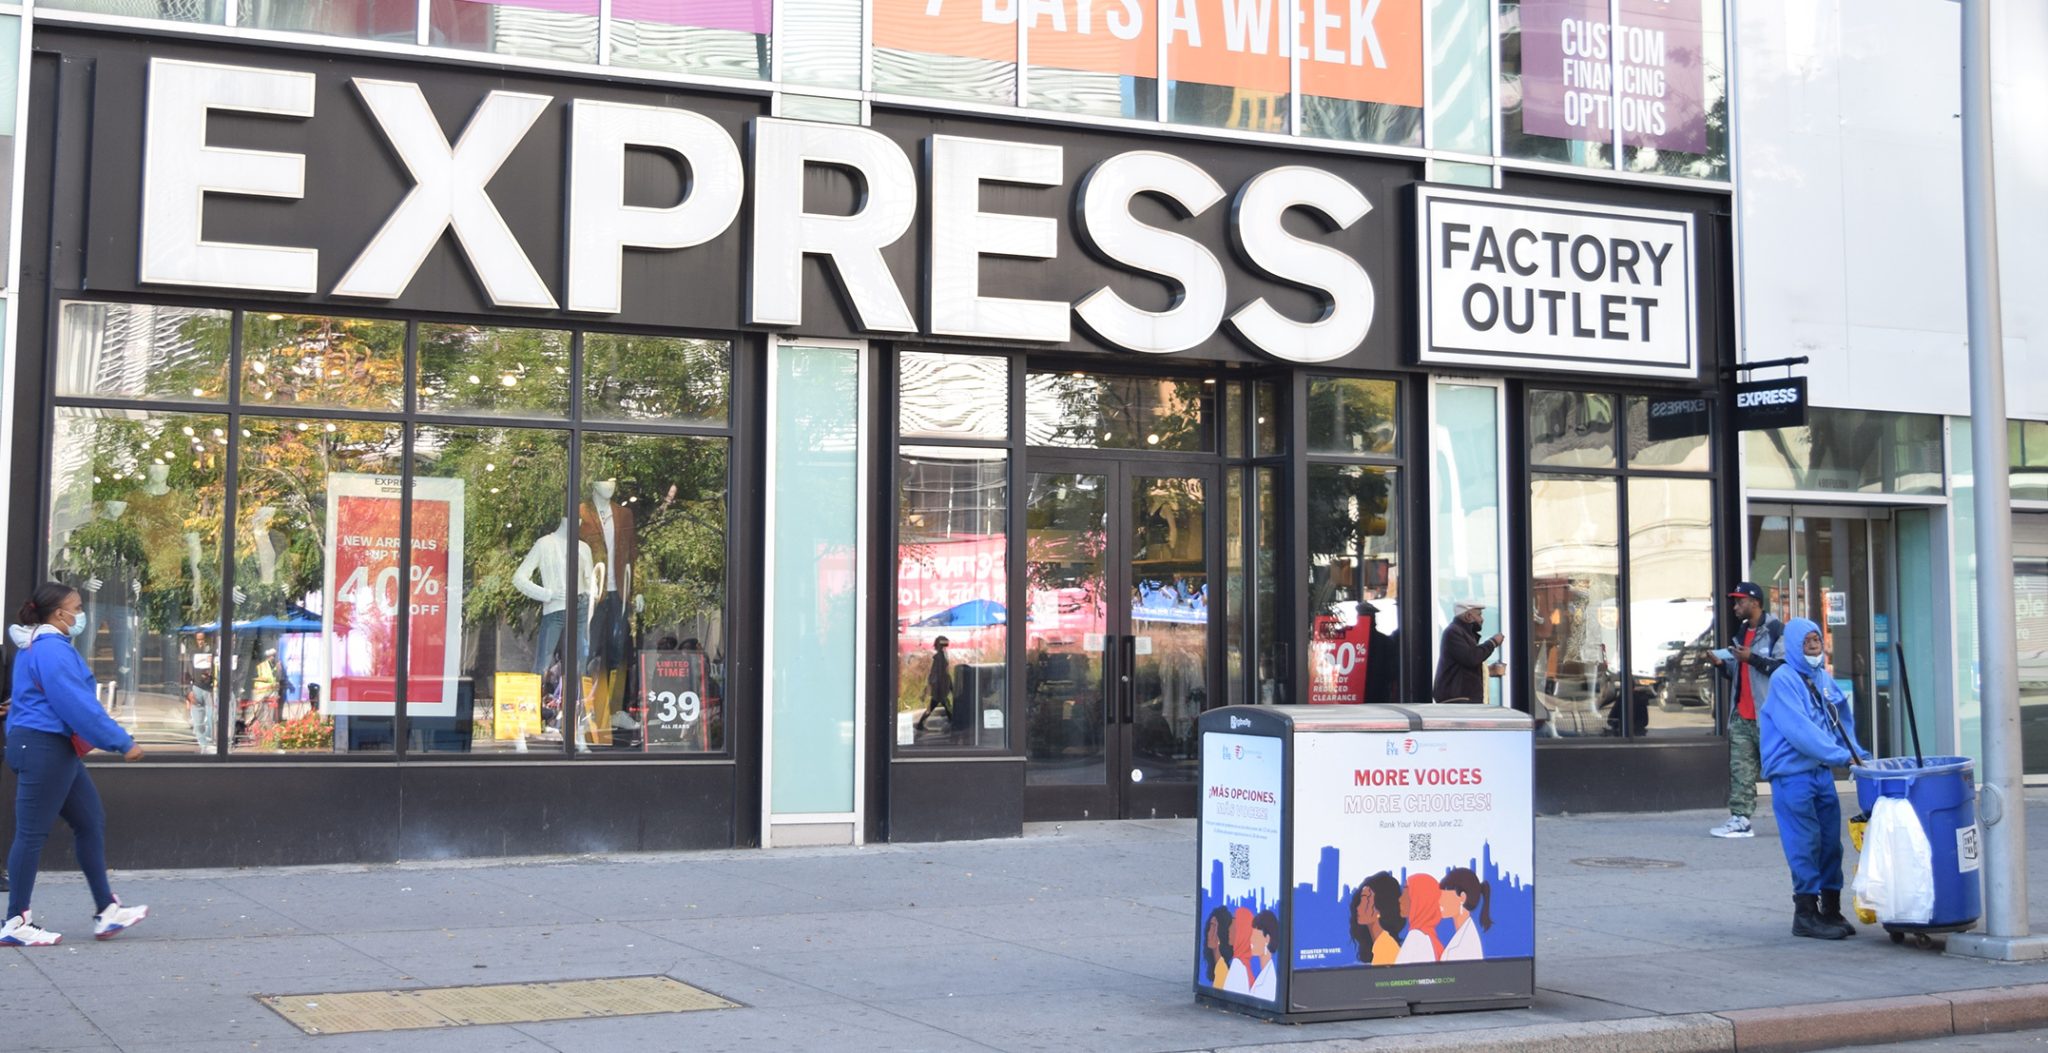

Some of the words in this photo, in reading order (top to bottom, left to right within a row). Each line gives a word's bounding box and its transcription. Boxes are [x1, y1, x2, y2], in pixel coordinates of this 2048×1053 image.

[1223, 0, 1388, 69] WEEK
[1562, 18, 1665, 67] CUSTOM
[1564, 90, 1666, 136] OPTIONS
[139, 57, 1375, 363] EXPRESS
[1442, 222, 1673, 287] FACTORY
[1462, 282, 1659, 343] OUTLET
[1737, 387, 1798, 408] EXPRESS
[375, 477, 417, 488] EXPRS
[343, 535, 372, 547] NEW
[376, 537, 437, 550] ARRALS
[409, 604, 440, 616] OFF
[657, 668, 689, 677] TIME!
[648, 690, 700, 722] $39
[1312, 694, 1357, 702] CLEARANCE
[1354, 769, 1410, 786] MORE
[1414, 768, 1483, 785] VOICES
[1231, 787, 1276, 805] OPCIONES,
[1343, 794, 1401, 814] MORE
[1404, 793, 1492, 812] CHOICES!
[1379, 820, 1395, 828] Rank
[1397, 820, 1411, 828] Your
[1413, 820, 1427, 828] Vote
[1438, 819, 1452, 828] June
